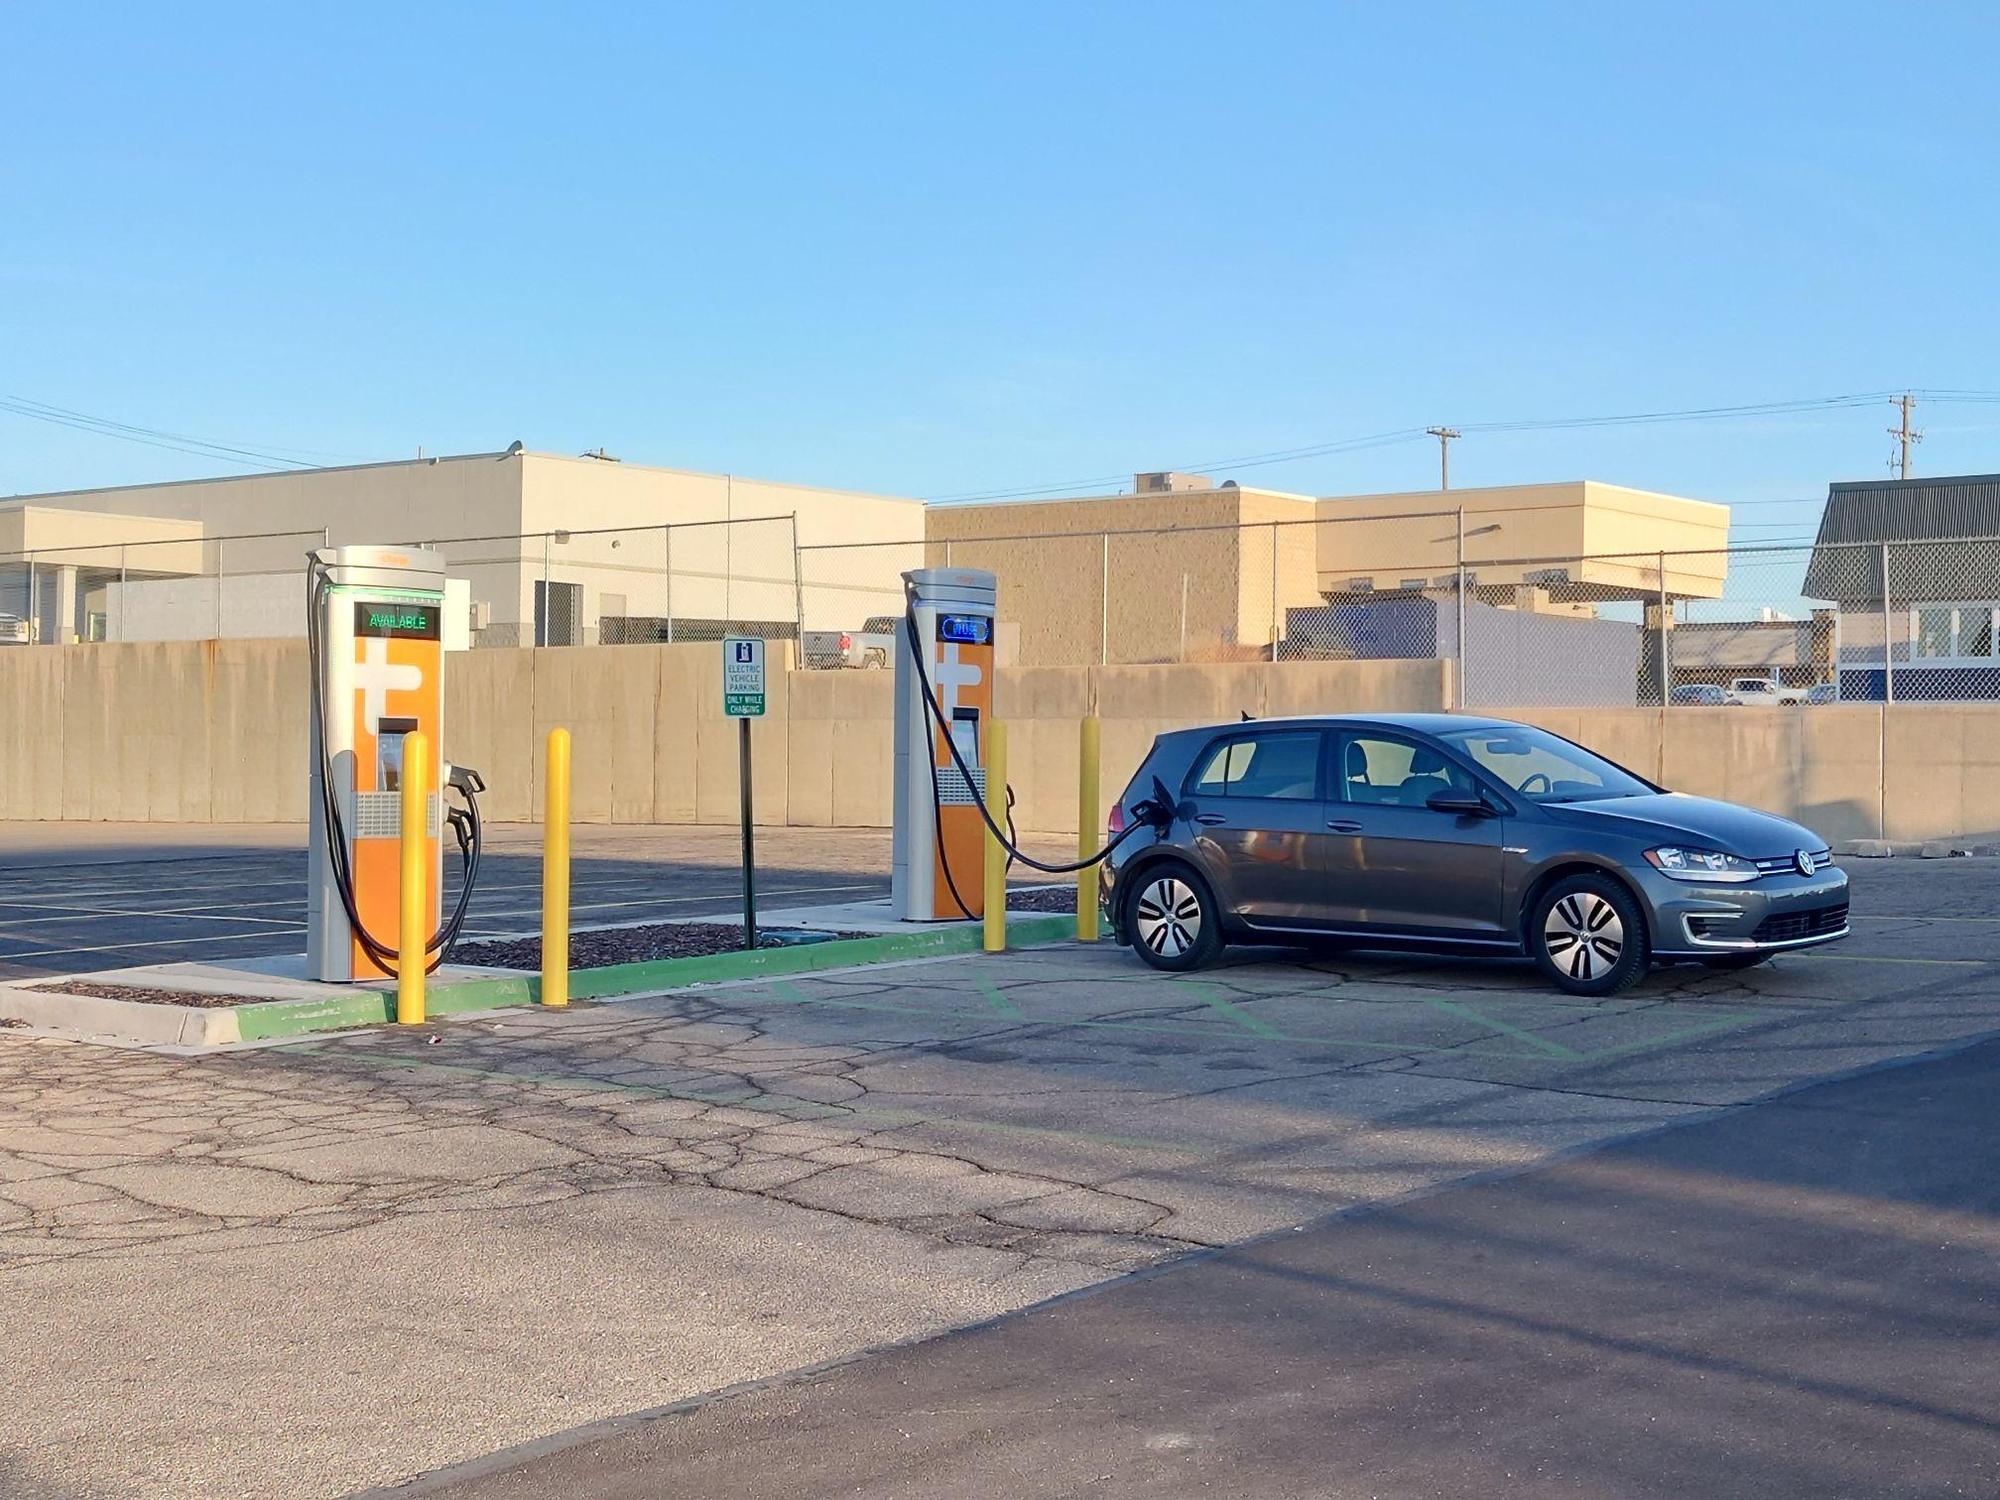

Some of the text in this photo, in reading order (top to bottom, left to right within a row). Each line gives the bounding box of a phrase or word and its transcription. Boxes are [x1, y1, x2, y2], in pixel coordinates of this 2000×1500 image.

[369, 614, 426, 630] AVAILABLE
[728, 665, 760, 673] ELECTRIC
[730, 674, 759, 682] VEHICLE
[730, 683, 760, 692] PARKING
[727, 696, 743, 704] ONLY
[730, 705, 760, 714] CHARGING
